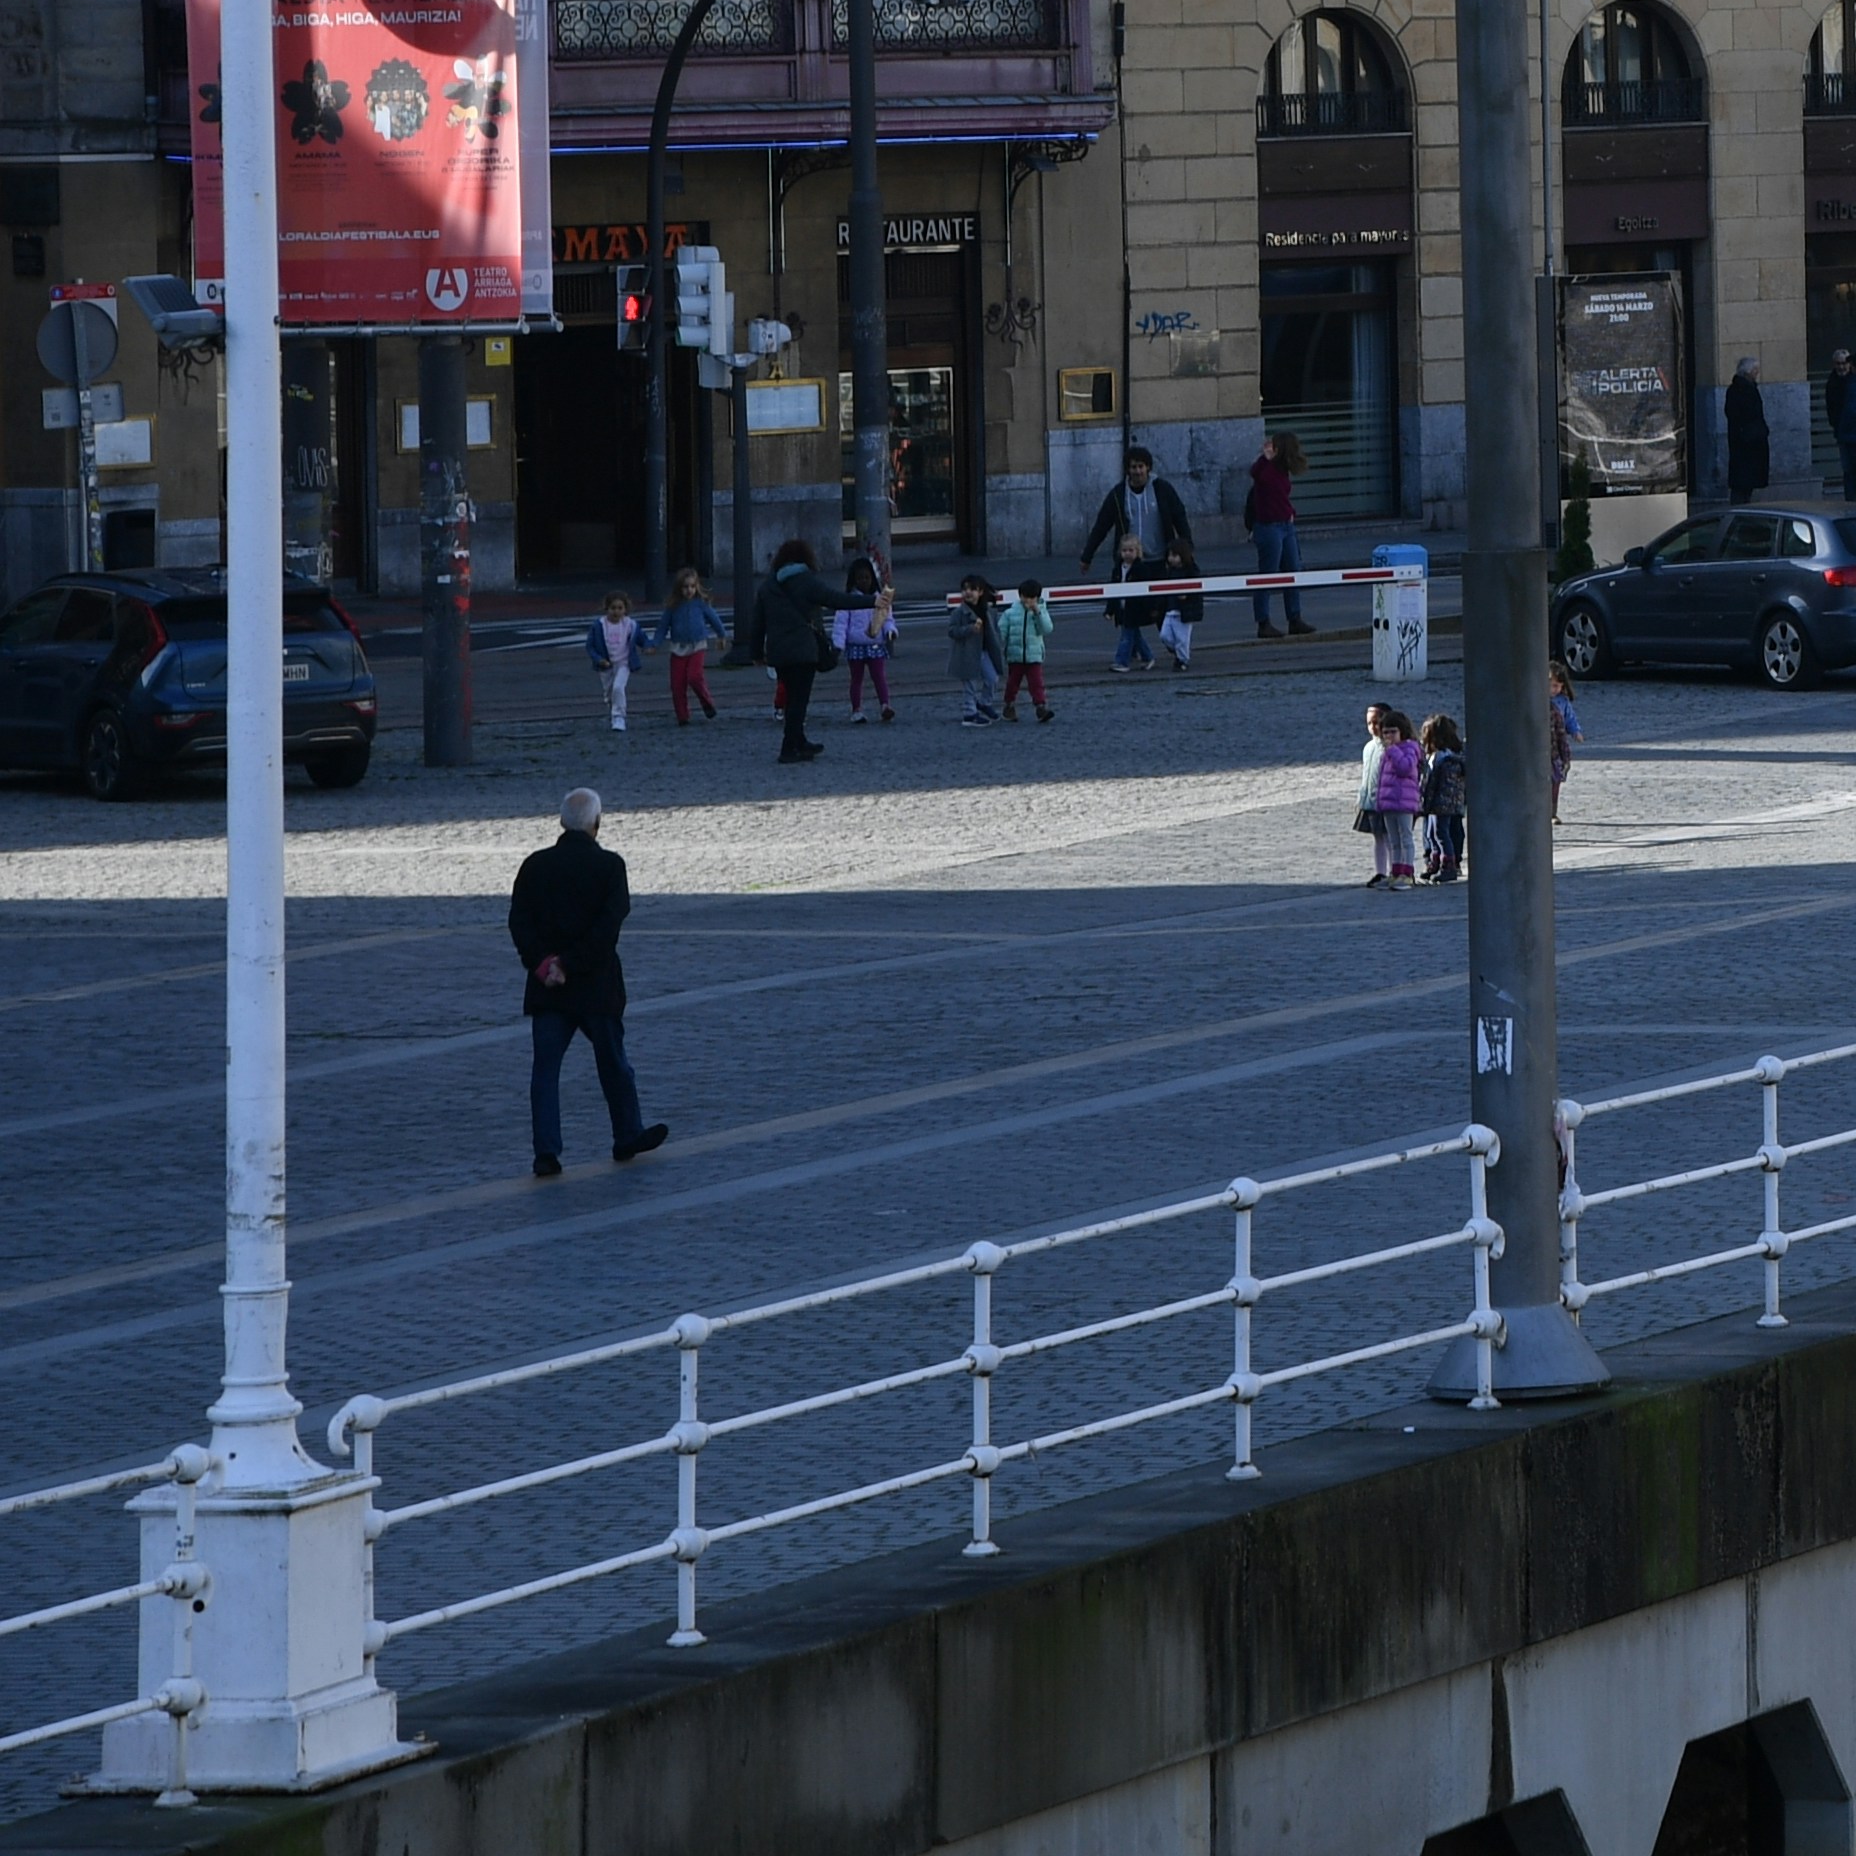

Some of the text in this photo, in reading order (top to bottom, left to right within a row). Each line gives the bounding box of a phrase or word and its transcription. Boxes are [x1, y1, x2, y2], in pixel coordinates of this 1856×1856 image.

[336, 10, 379, 28] HIGA,
[381, 9, 462, 25] MAURIZIA!
[838, 216, 976, 245] RAURANTE
[1265, 231, 1329, 247] Residencia
[1360, 229, 1410, 244] mayores
[552, 224, 692, 263] MAA
[473, 266, 508, 277] TEATRO
[474, 277, 513, 288] ARRIAGA
[474, 287, 517, 299] ANTZOKIA
[1625, 301, 1654, 312] MARZO
[1600, 366, 1659, 381] ALERTA
